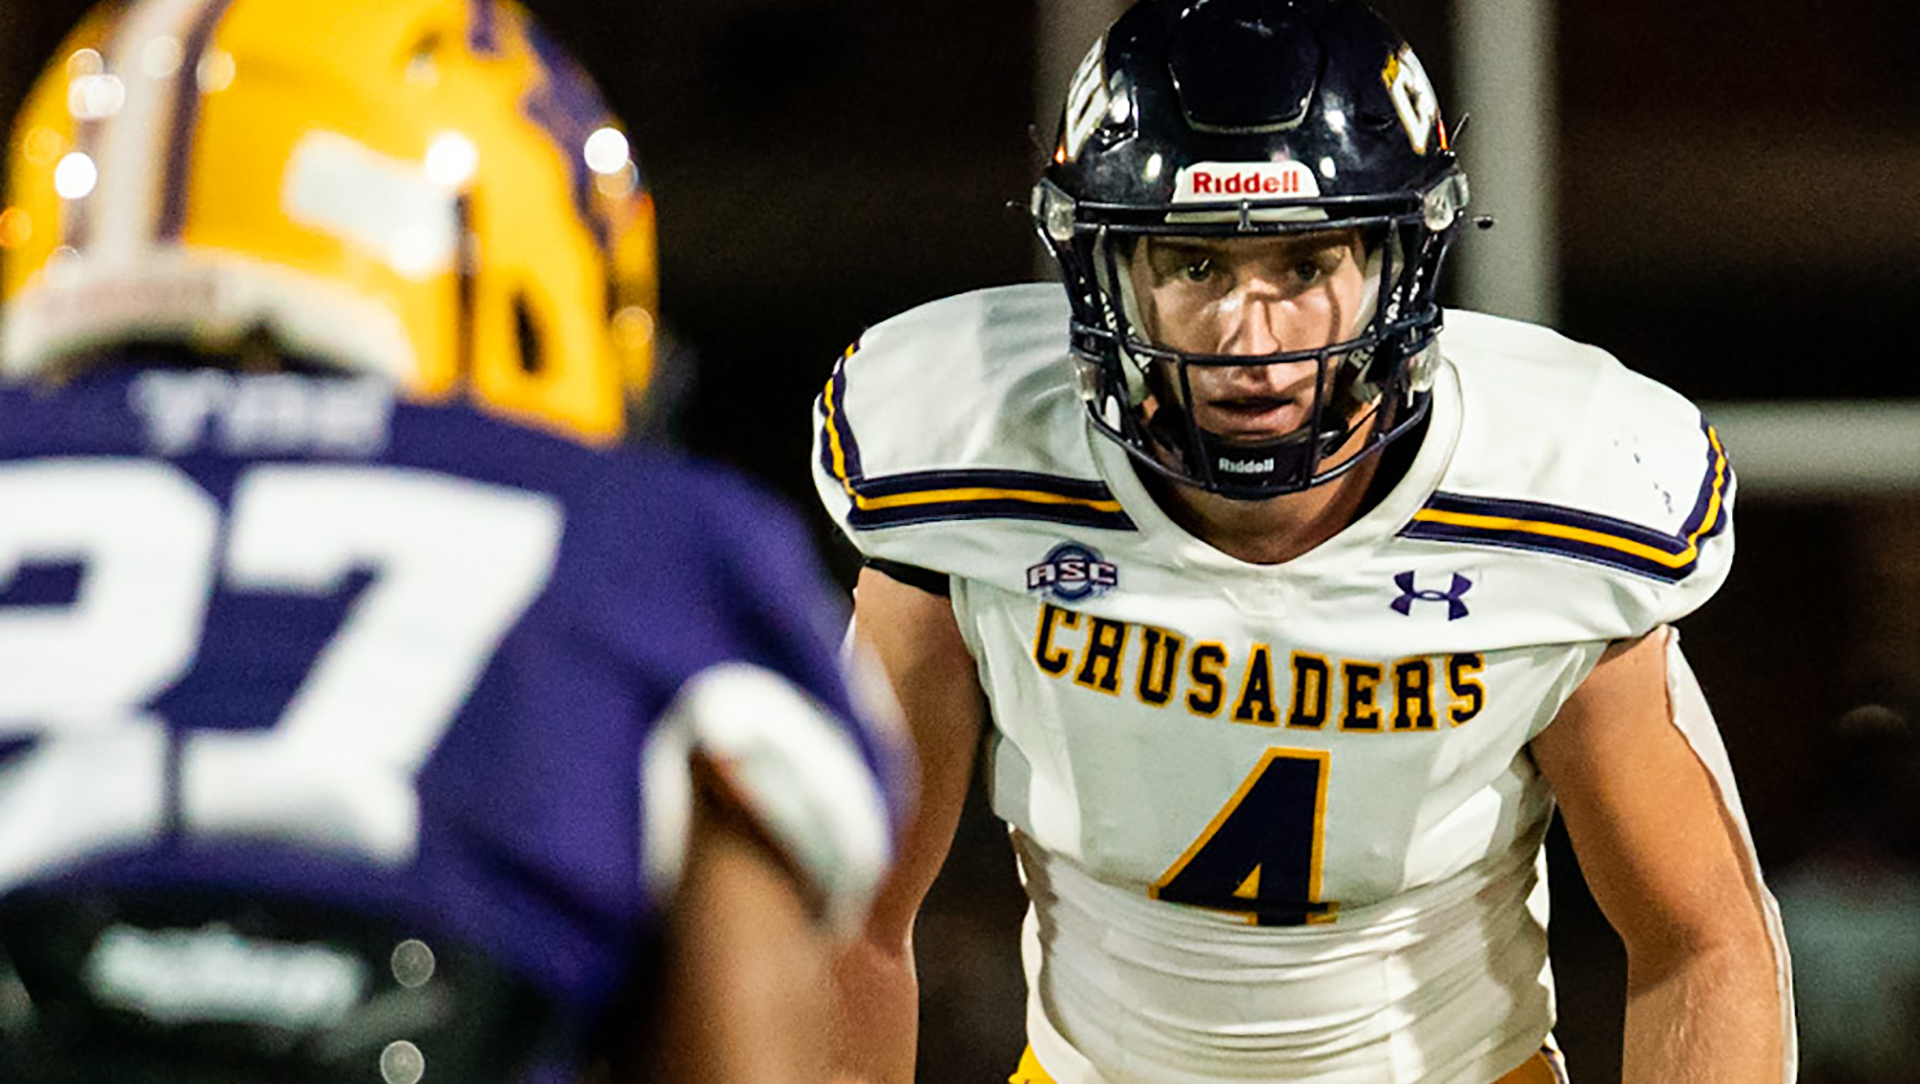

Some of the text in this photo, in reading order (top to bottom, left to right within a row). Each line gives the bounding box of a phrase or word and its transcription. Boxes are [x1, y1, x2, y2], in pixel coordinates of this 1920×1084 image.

[1193, 171, 1299, 194] Riddell
[1219, 457, 1275, 473] Riddell
[1027, 559, 1118, 589] ASC
[1033, 601, 1487, 733] CRUSADERS
[1148, 746, 1340, 927] 4
